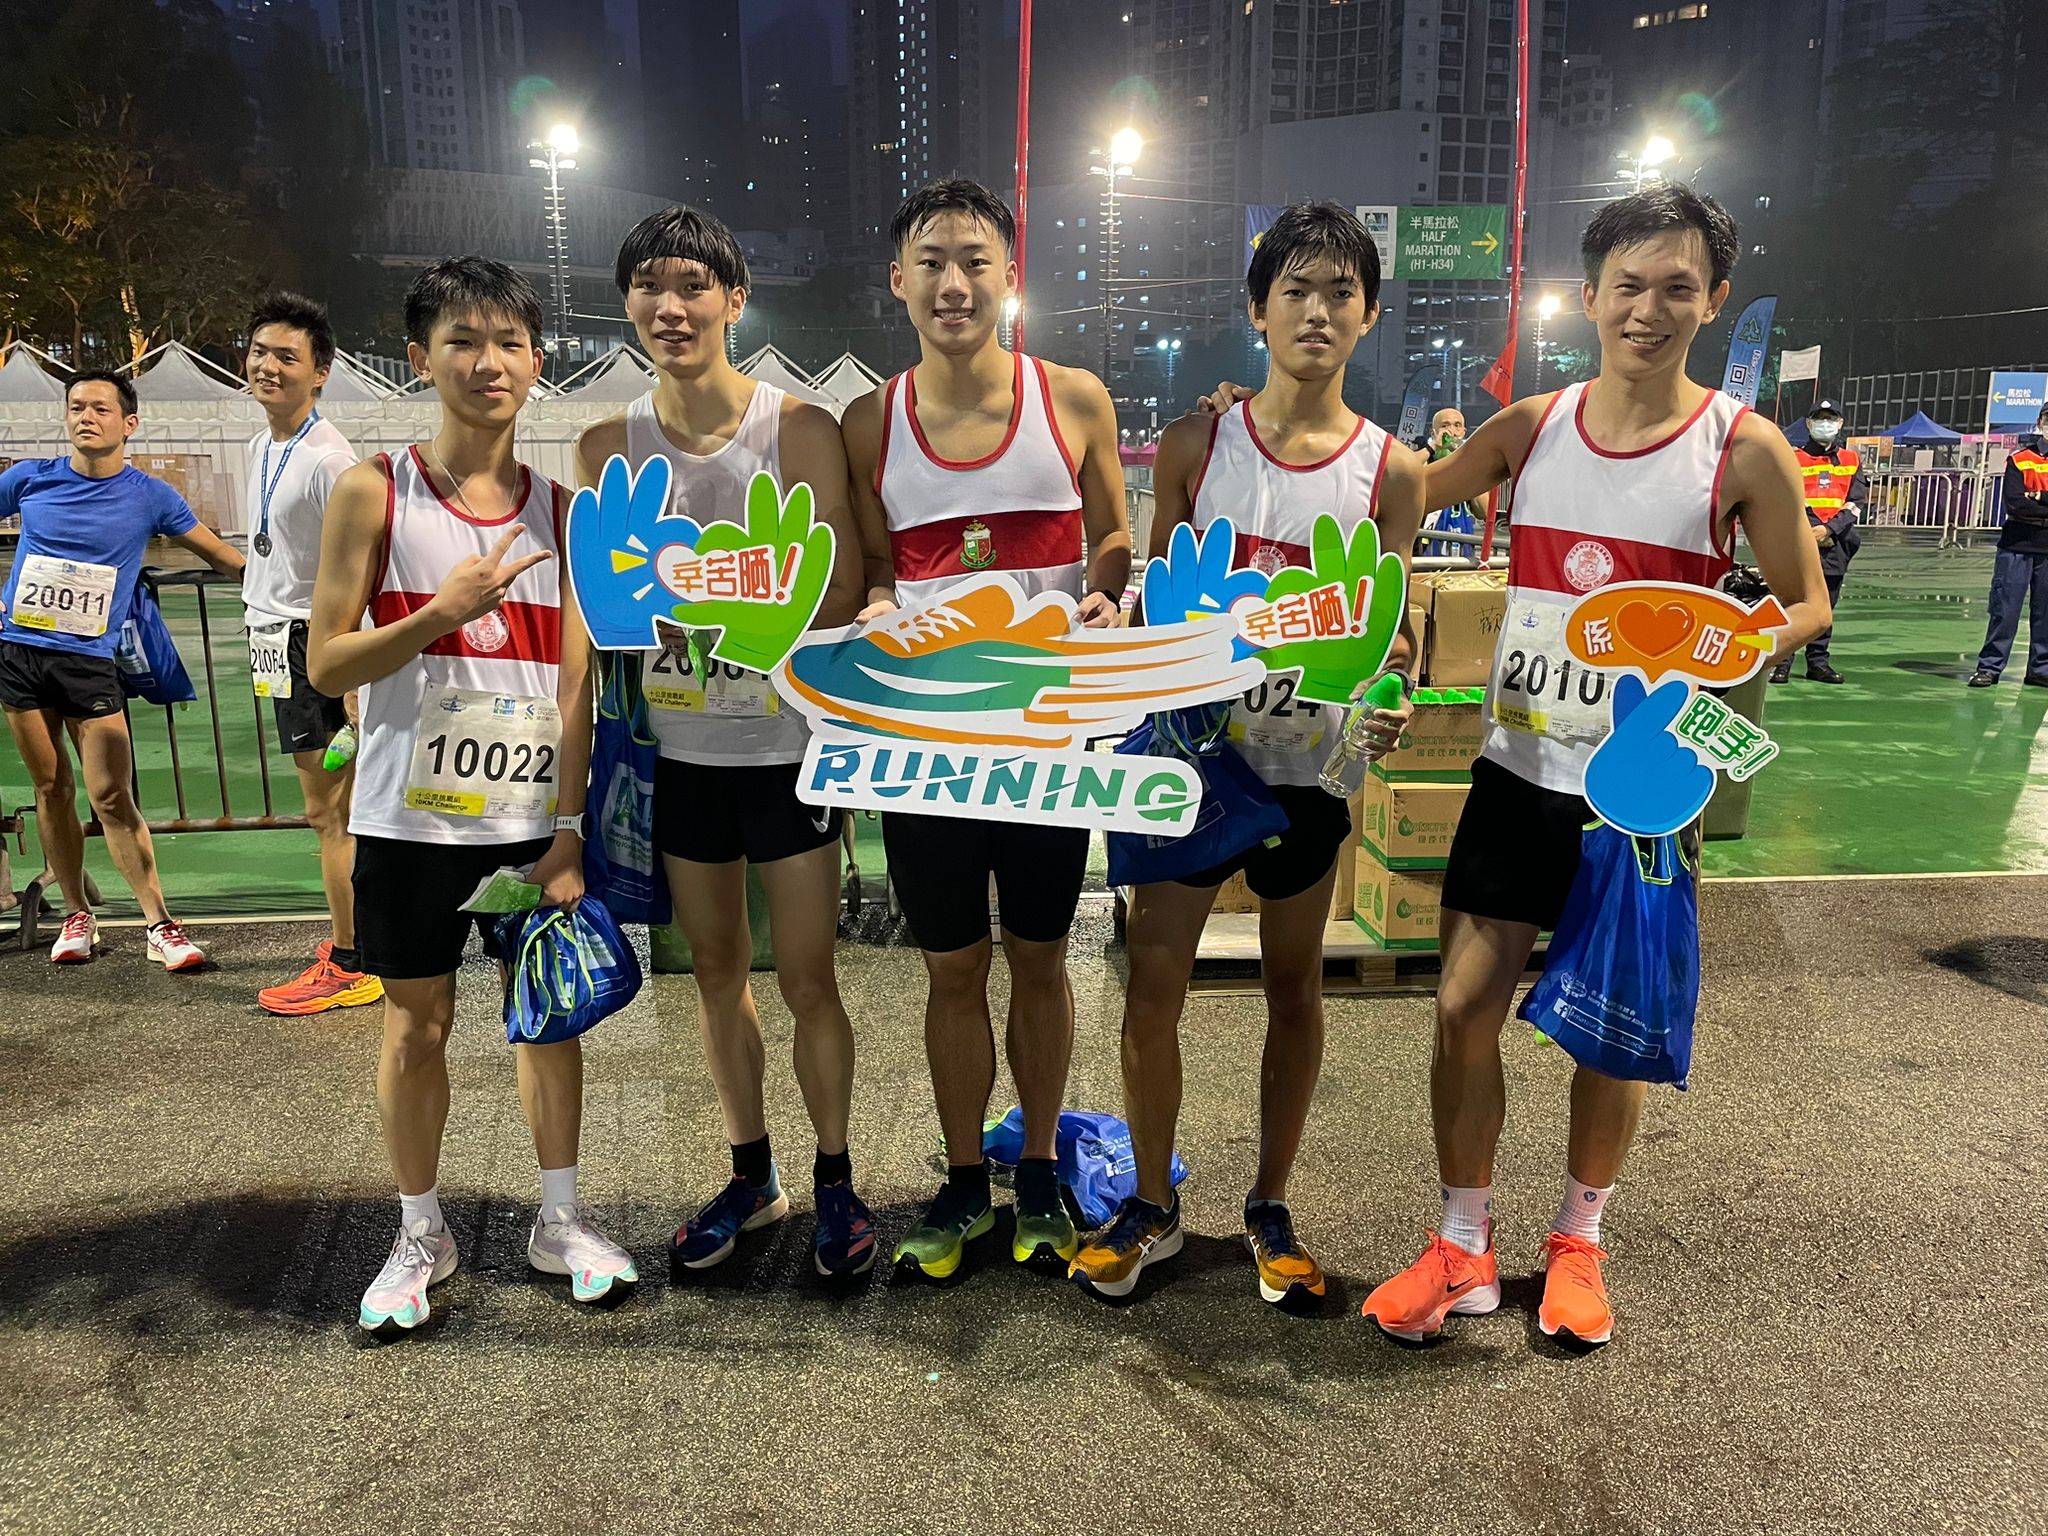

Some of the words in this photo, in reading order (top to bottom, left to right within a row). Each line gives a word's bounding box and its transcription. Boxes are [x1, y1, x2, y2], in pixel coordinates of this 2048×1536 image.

[1410, 215, 1459, 230] 半馬拉松
[1421, 231, 1447, 242] HALF
[1405, 244, 1462, 257] MARATHON
[1410, 258, 1454, 272] (H1-H34)
[2005, 398, 2043, 406] MARATHON
[21, 582, 105, 616] 20011
[1502, 650, 1611, 706] 2010
[664, 699, 692, 707] Challenge
[427, 734, 555, 784] 10022
[809, 742, 1201, 823] RUNNING
[415, 798, 434, 807] 10KM
[435, 800, 468, 811] Challenge
